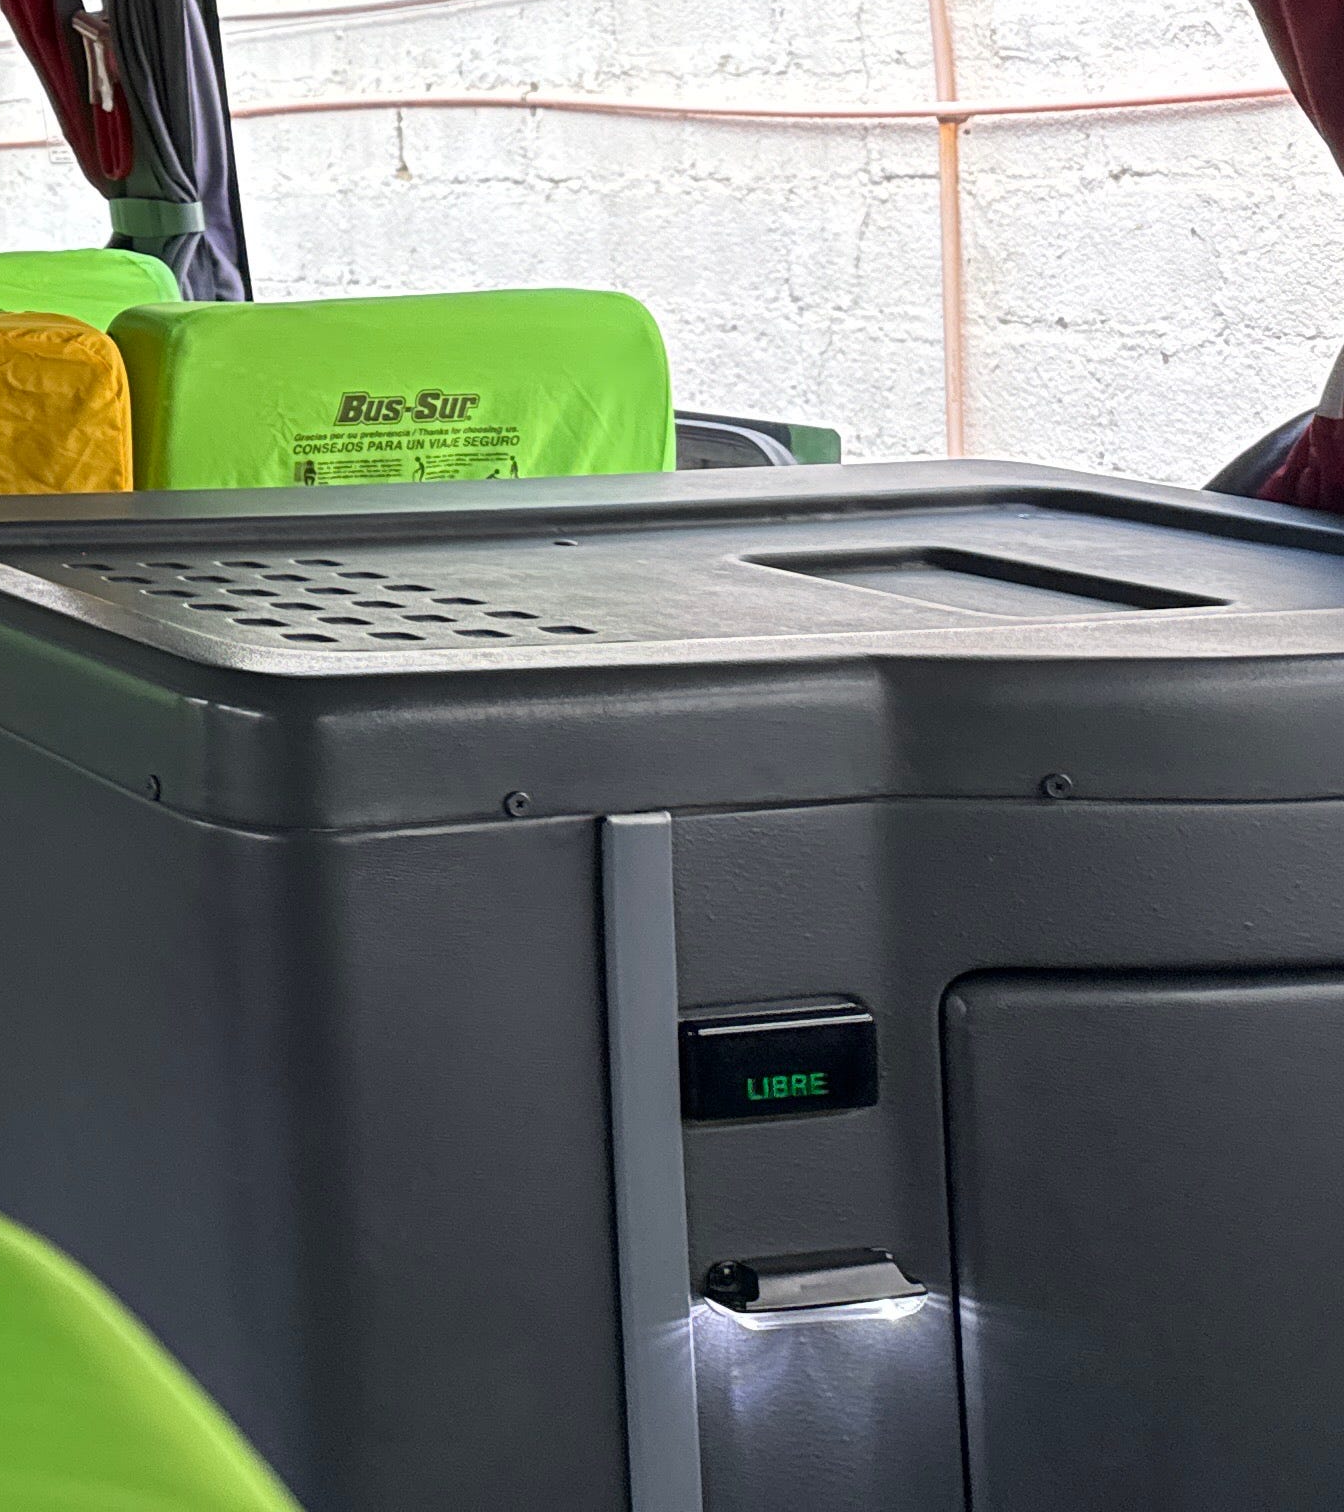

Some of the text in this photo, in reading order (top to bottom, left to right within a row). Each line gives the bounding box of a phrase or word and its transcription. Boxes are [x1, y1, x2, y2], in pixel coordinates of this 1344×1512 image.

[333, 388, 480, 426] Bus-Sur
[418, 427, 449, 436] Thanks
[293, 435, 520, 455] CONSEJOS PARA UN VIAJE SEGURO
[746, 1072, 830, 1100] LIBRE
